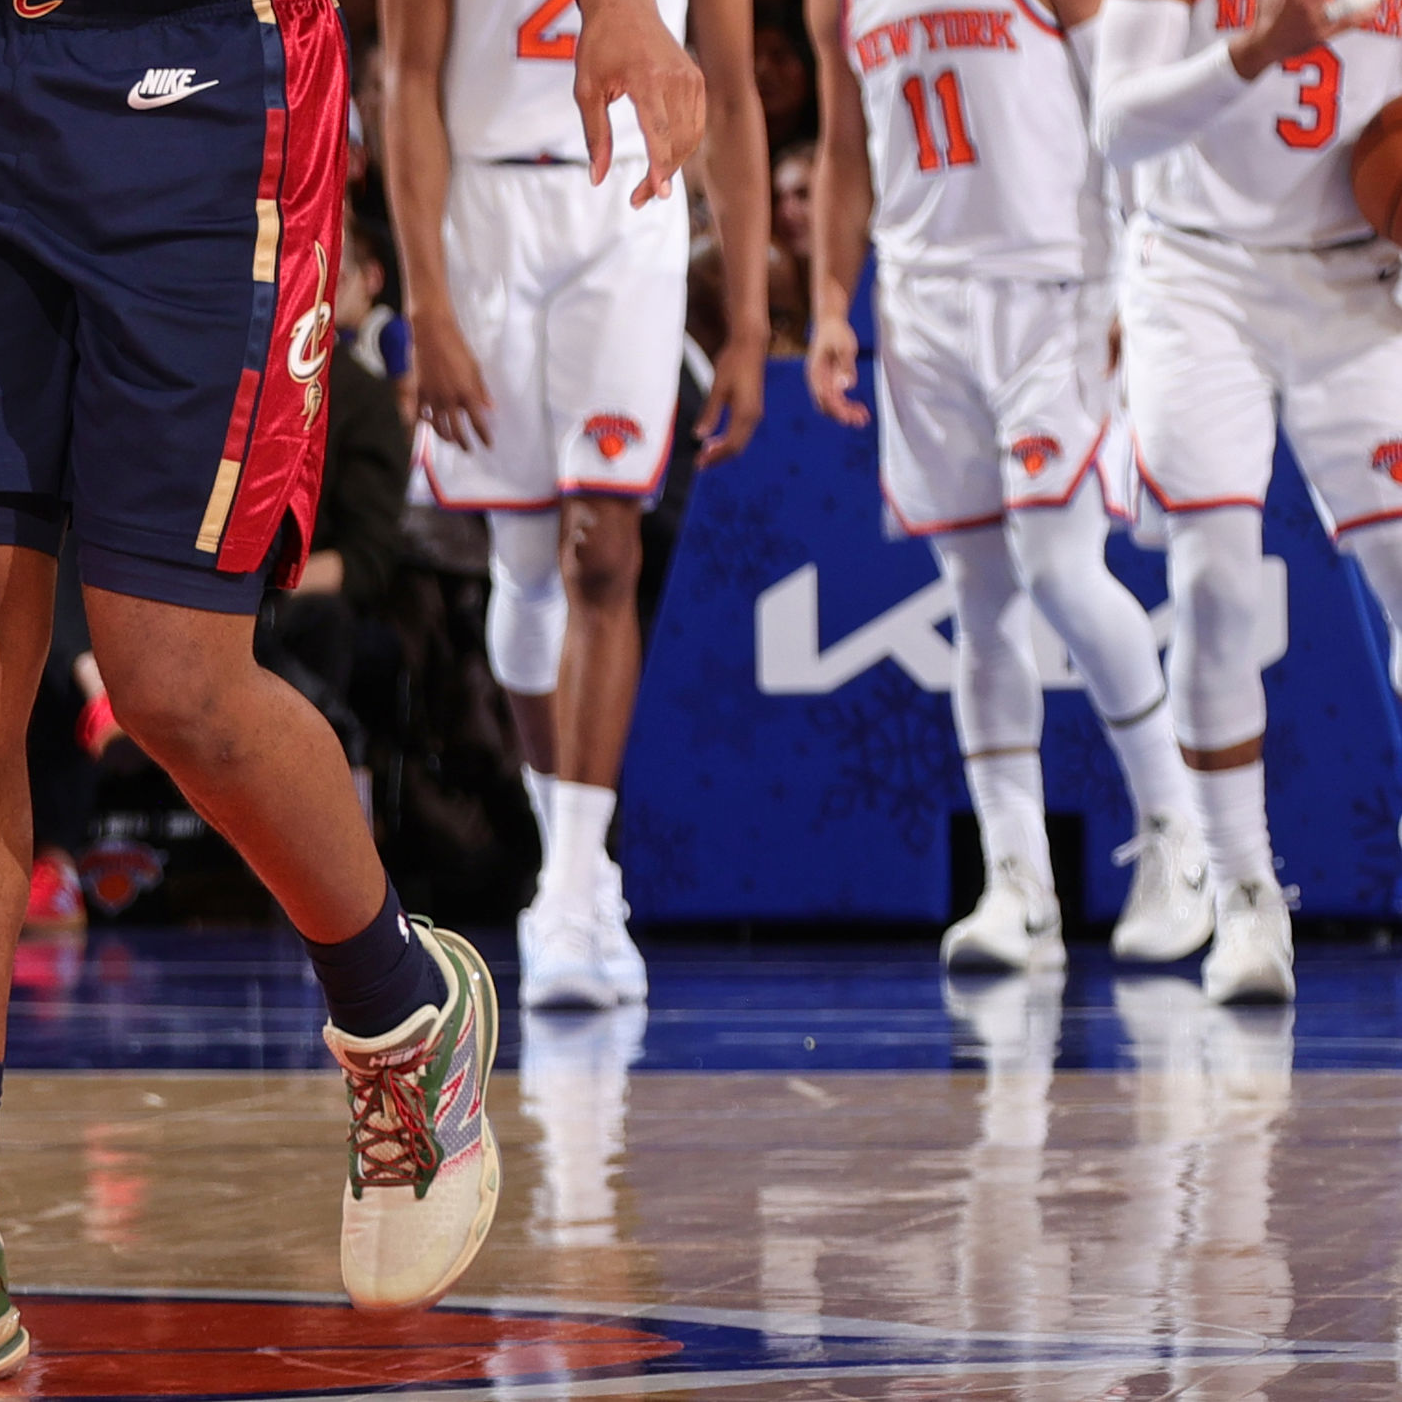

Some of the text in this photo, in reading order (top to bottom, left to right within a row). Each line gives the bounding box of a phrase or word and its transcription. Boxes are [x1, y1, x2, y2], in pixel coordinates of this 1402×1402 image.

[138, 68, 197, 95] NIKE
[855, 8, 1018, 75] NEW YORK
[902, 69, 978, 172] 11
[1276, 42, 1342, 150] 3
